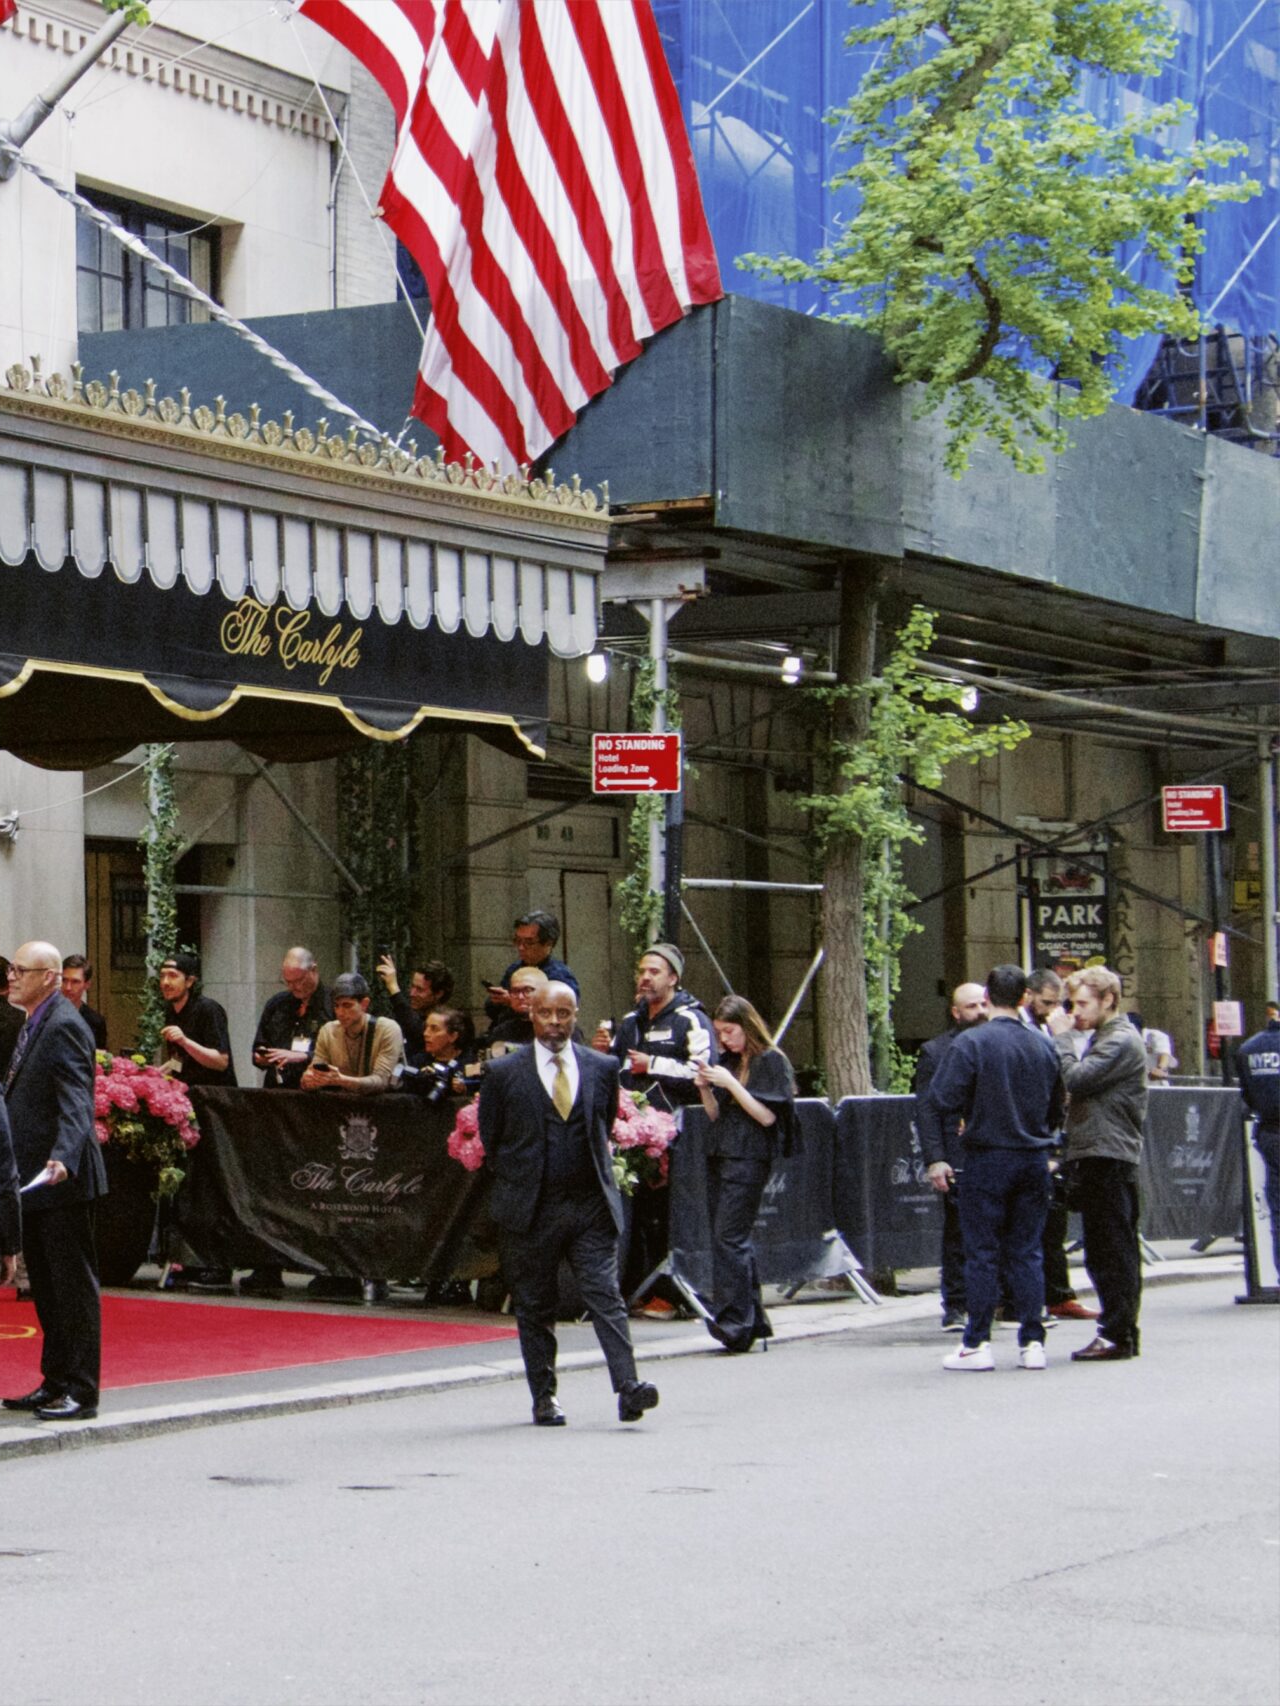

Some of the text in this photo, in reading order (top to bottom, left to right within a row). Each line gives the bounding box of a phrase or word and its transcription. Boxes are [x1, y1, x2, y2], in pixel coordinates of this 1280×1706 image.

[221, 595, 364, 686] The Carlyle
[598, 739, 666, 751] NO STANDING
[598, 753, 620, 762] Hotel
[598, 764, 650, 774] Loading Zone
[1038, 904, 1103, 926] PARK
[1042, 931, 1087, 940] Welcome
[1249, 1052, 1280, 1068] NYPD
[291, 1162, 425, 1203] The Carlyle
